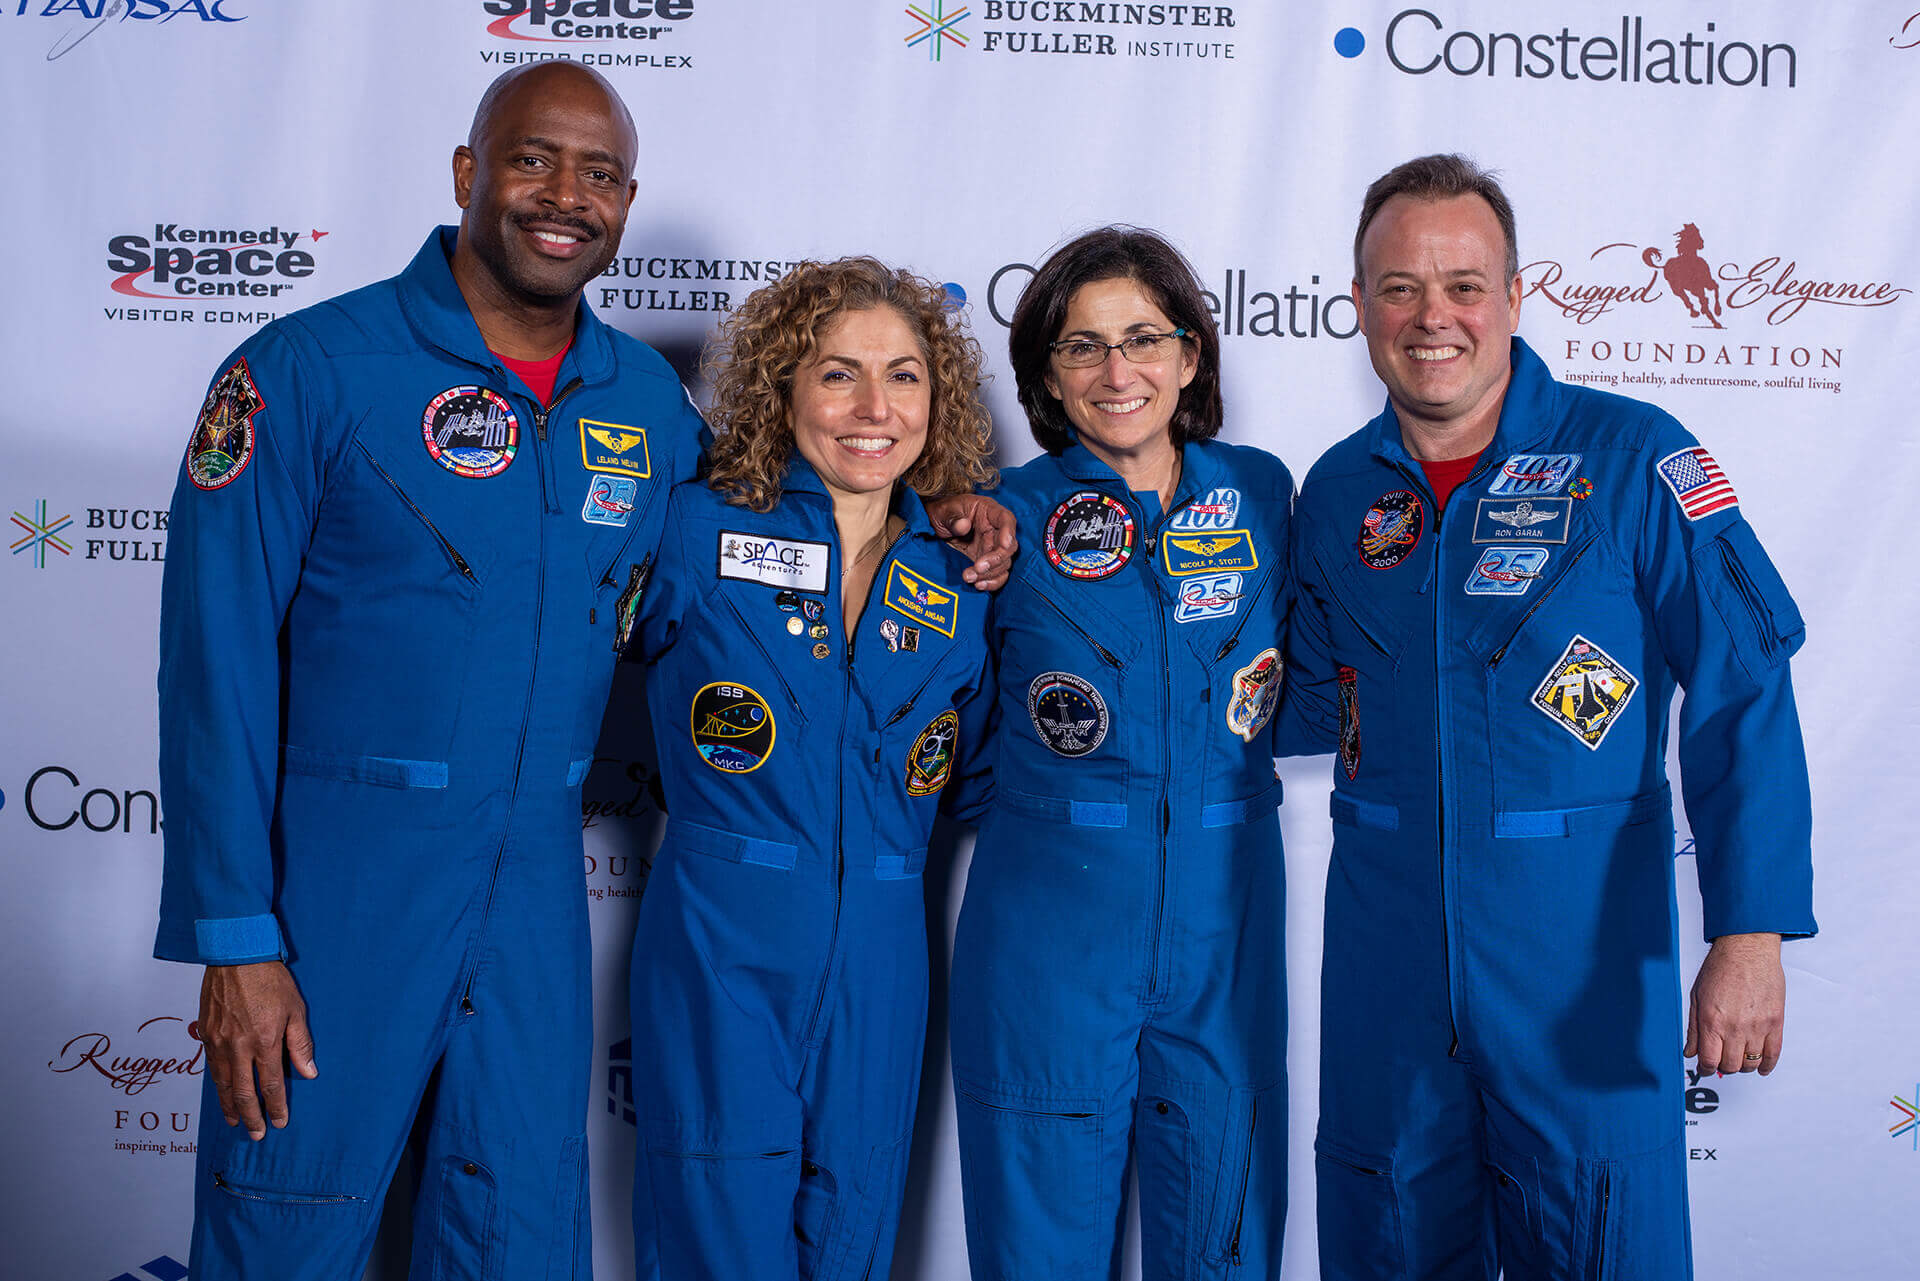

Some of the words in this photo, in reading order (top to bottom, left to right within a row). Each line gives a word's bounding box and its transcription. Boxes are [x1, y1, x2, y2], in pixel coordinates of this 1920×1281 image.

[983, 0, 1236, 28] BUCKMINSTER
[551, 19, 663, 40] Center
[983, 31, 1117, 55] FULLER
[1128, 41, 1235, 59] INSTITUTE
[1385, 9, 1797, 88] Constellation
[582, 53, 692, 68] COMPLEX
[155, 223, 300, 249] Kennedy
[107, 235, 315, 283] Space
[174, 276, 284, 297] Center
[1518, 258, 1663, 325] Rugged
[1718, 256, 1913, 326] Elegance
[599, 288, 733, 312] FULLER
[104, 308, 194, 322] VISITOR
[1565, 340, 1842, 369] FOUNDATION
[1565, 370, 1618, 386] inspiring
[1622, 371, 1667, 387] healthy,
[1670, 374, 1761, 389] adventuresome,
[1764, 376, 1804, 389] soulful
[1808, 377, 1842, 393] living
[1495, 529, 1512, 537] RON
[1515, 529, 1543, 537] GARAN
[743, 541, 805, 567] SPACE
[1179, 560, 1206, 569] NICOLE
[1218, 557, 1242, 566] STOTT
[1372, 555, 1399, 567] 2000
[717, 686, 744, 698] ISS
[114, 1138, 167, 1156] inspiring
